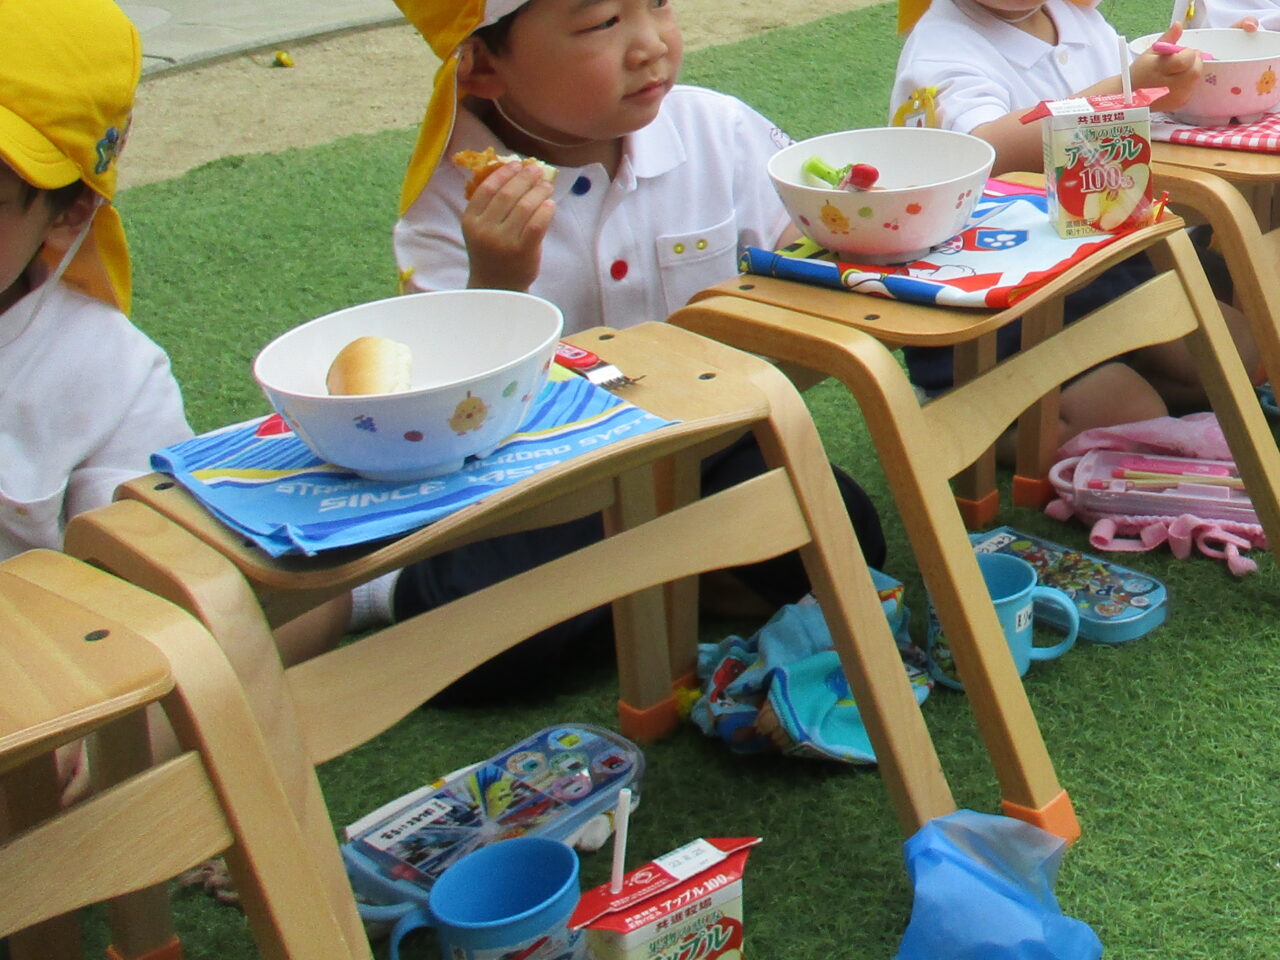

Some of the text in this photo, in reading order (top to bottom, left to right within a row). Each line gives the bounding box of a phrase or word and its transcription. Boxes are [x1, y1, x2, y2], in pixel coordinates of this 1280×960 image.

[1077, 111, 1125, 125] 共進牧場
[1064, 138, 1144, 169] アップル
[1079, 164, 1135, 193] 100%
